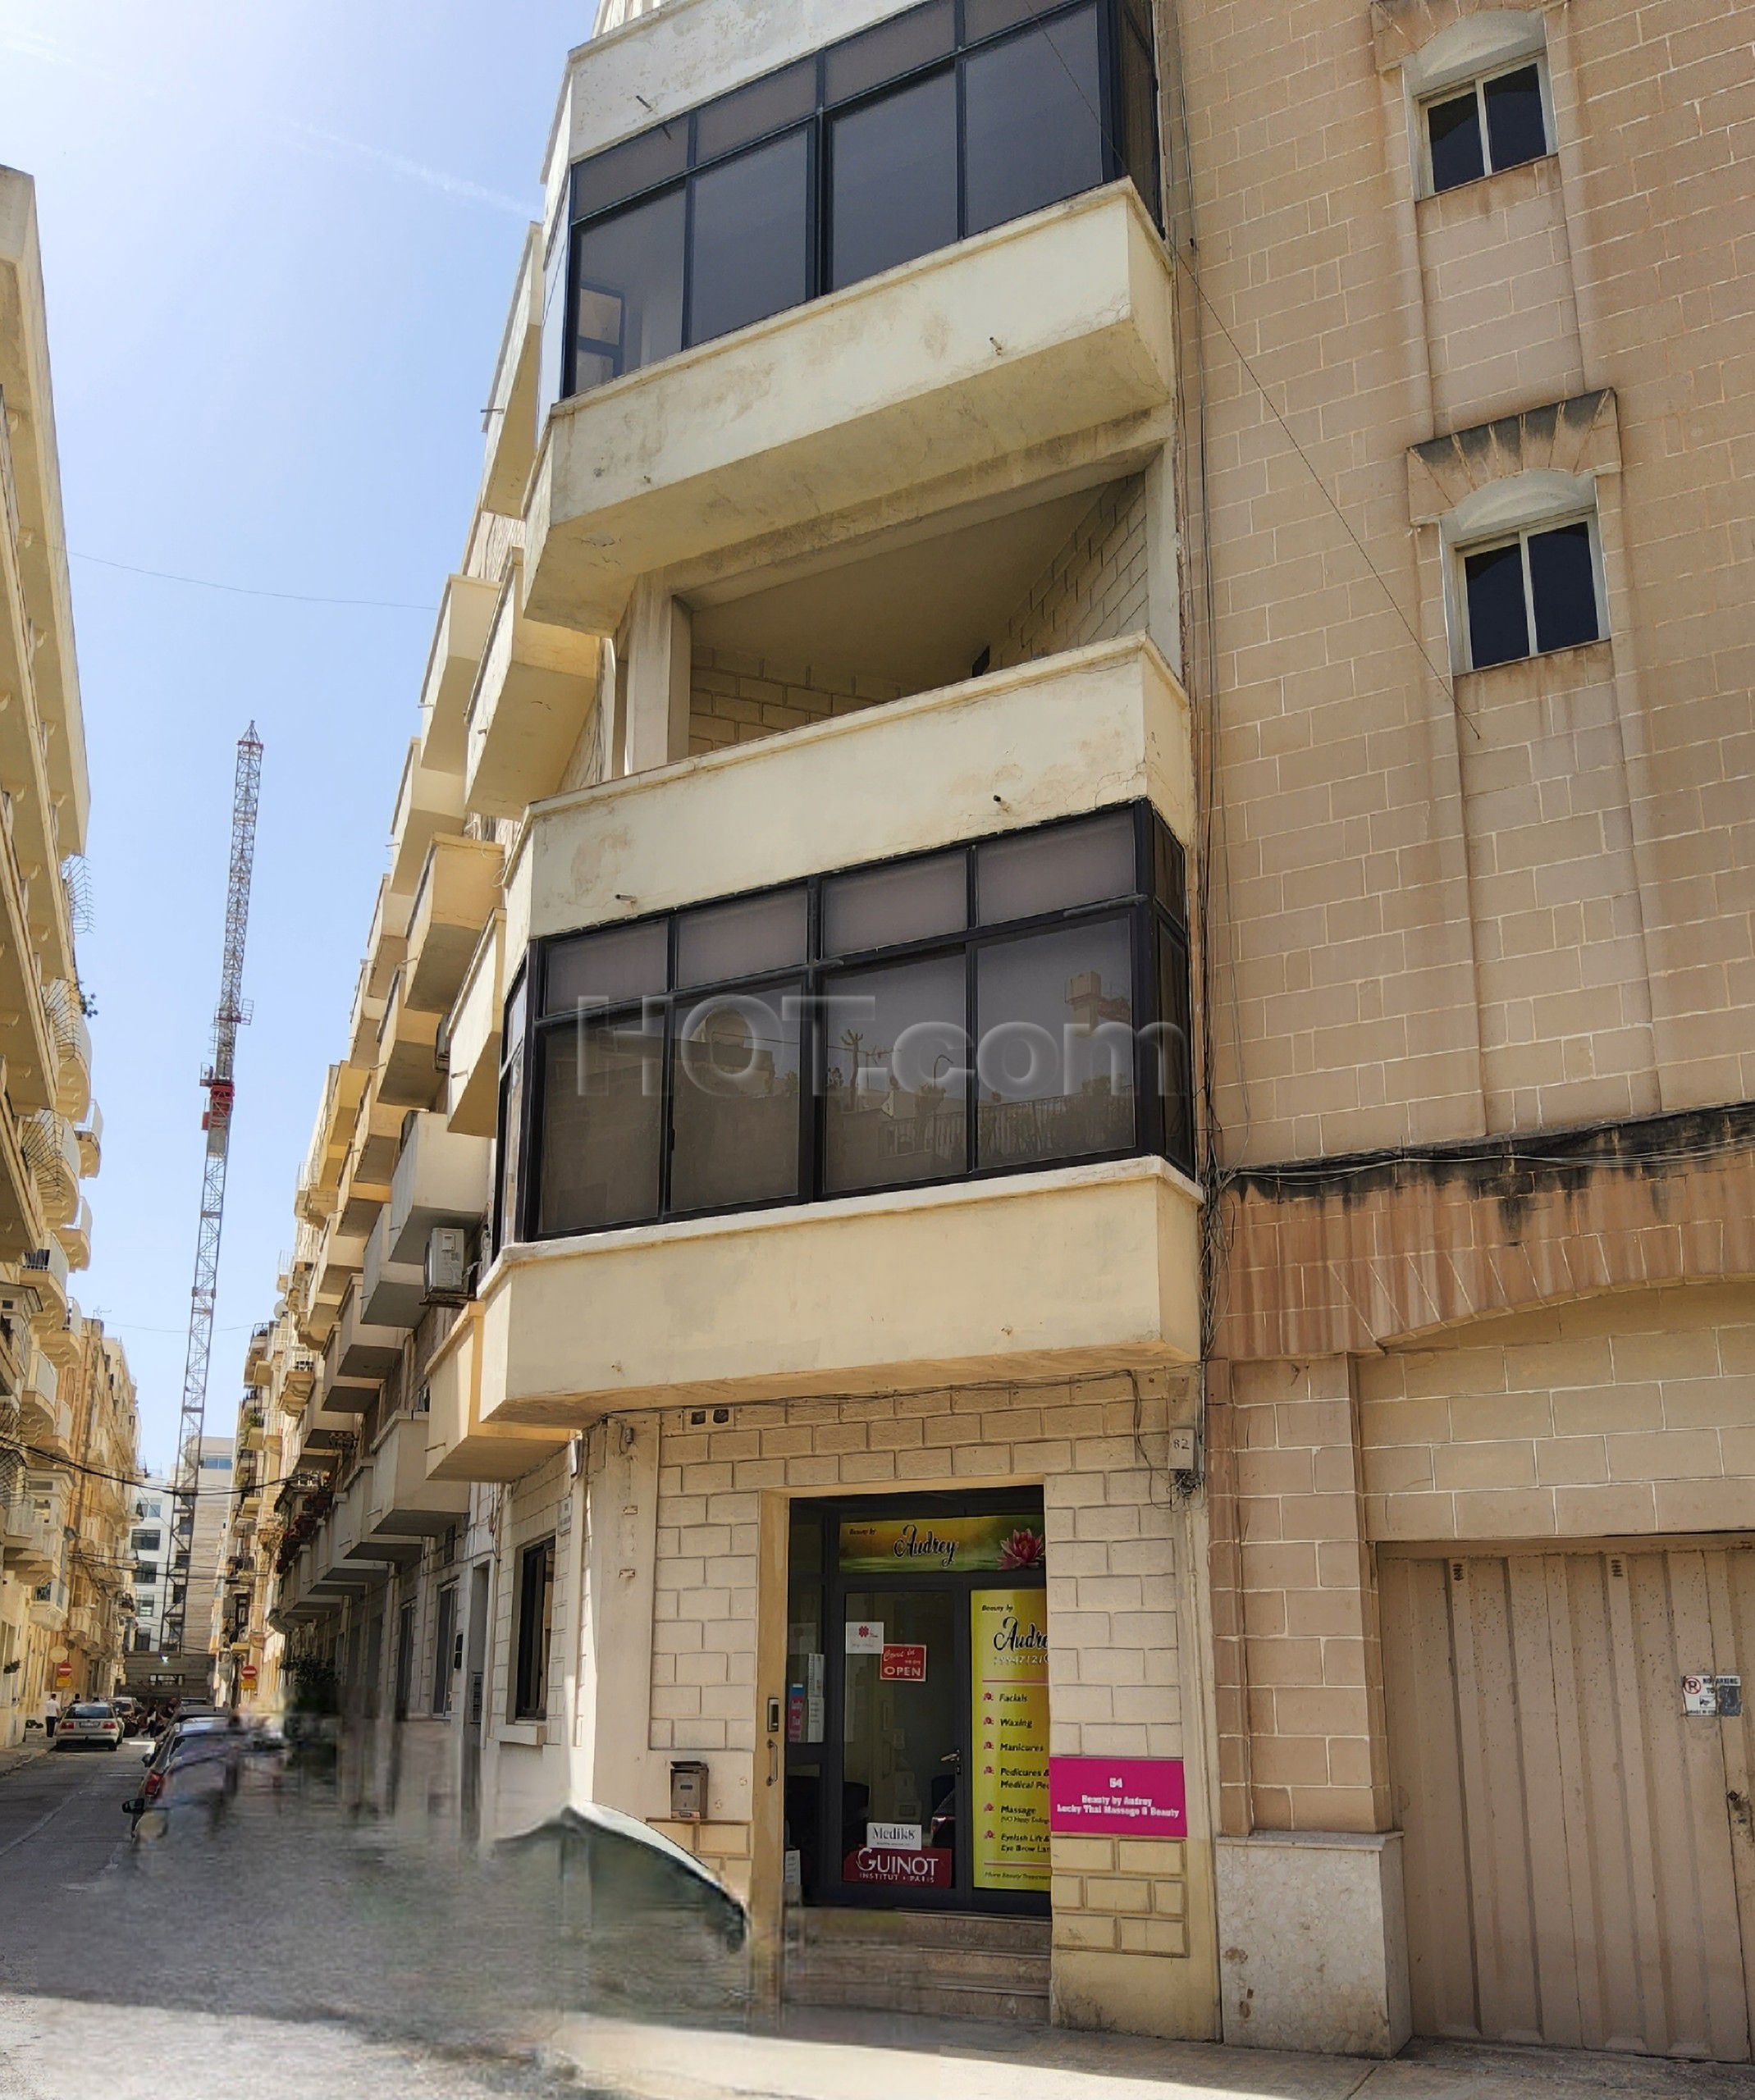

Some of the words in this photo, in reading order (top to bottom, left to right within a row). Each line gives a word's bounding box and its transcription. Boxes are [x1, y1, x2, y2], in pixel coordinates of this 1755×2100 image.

[893, 1523, 958, 1568] Audrey
[884, 1666, 921, 1677] OPEN
[999, 1693, 1028, 1702] Facials
[1000, 1718, 1033, 1729] Waxing
[1000, 1742, 1044, 1752] Manicures
[1000, 1768, 1041, 1776] Pedicures
[1000, 1780, 1034, 1788] Medical
[1081, 1794, 1110, 1806] Beauty
[1112, 1796, 1122, 1806] by
[1124, 1796, 1152, 1807] Audrey
[1000, 1806, 1036, 1816] Massage
[1057, 1804, 1082, 1815] Lucky
[1083, 1805, 1101, 1814] Thai
[1104, 1806, 1140, 1817] Massage
[1150, 1807, 1180, 1819] Beauty
[1001, 1833, 1028, 1842] Eyelash
[1001, 1844, 1014, 1853] Eye
[856, 1847, 939, 1876] GUINOT
[859, 1872, 898, 1881] INSTITUT
[909, 1875, 935, 1883] PARIS
